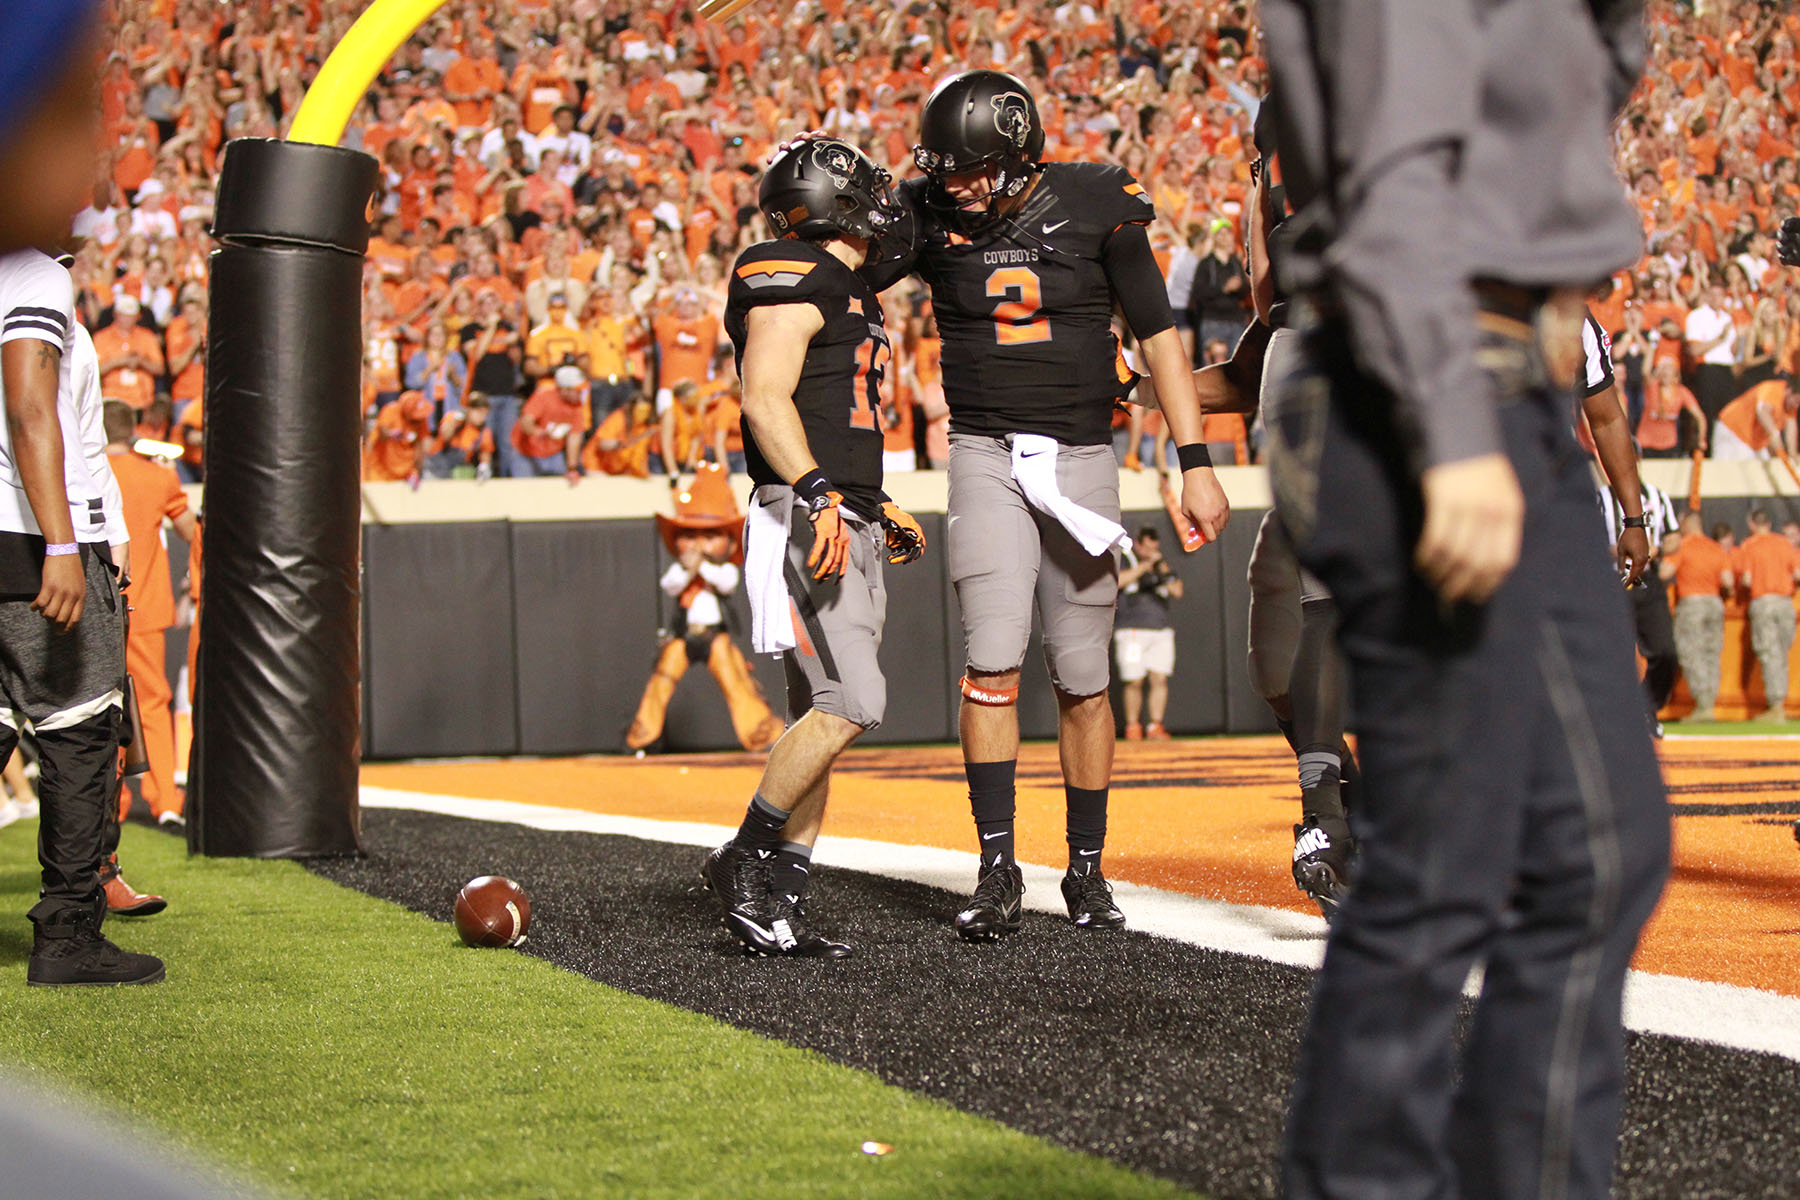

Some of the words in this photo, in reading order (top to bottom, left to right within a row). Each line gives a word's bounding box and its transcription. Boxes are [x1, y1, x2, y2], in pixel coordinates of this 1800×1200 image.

[983, 248, 1039, 265] COWBOYS
[985, 266, 1053, 346] 2
[978, 692, 1010, 704] Mueller
[771, 918, 798, 951] NIKE
